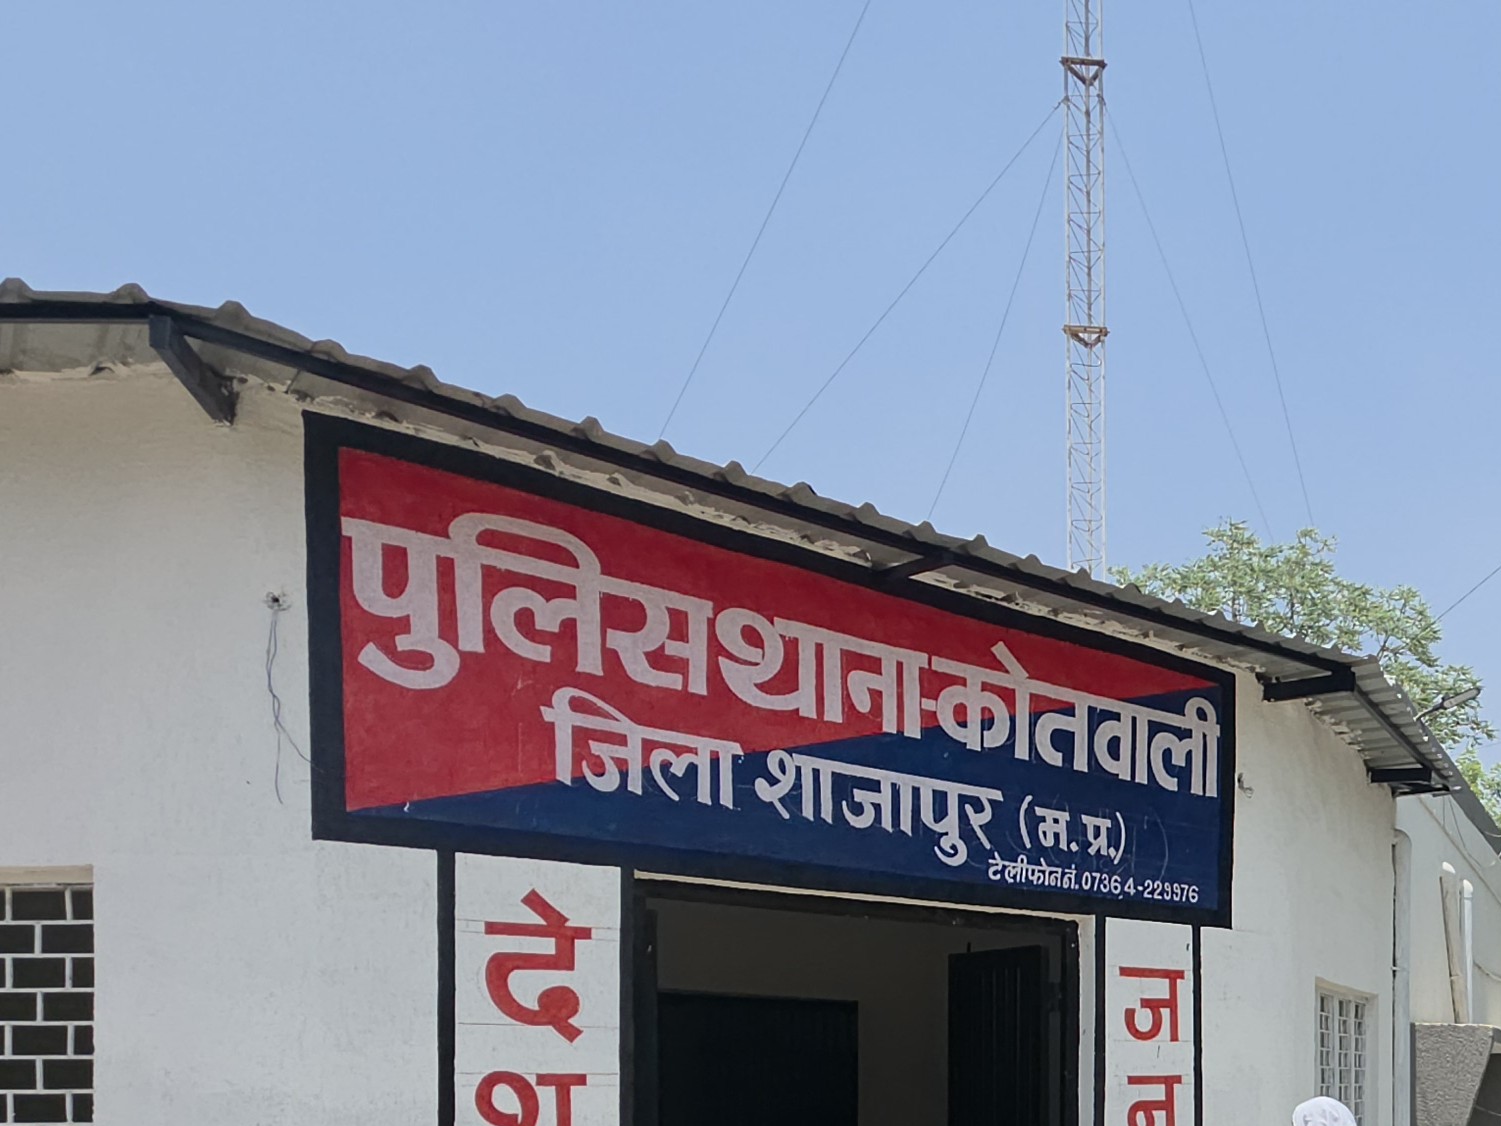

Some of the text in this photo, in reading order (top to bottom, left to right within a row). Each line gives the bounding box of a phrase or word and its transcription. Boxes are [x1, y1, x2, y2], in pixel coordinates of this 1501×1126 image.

[341, 512, 713, 696] पुलिस
[539, 686, 744, 810] जिला
[755, 749, 1004, 867] शाजापुर
